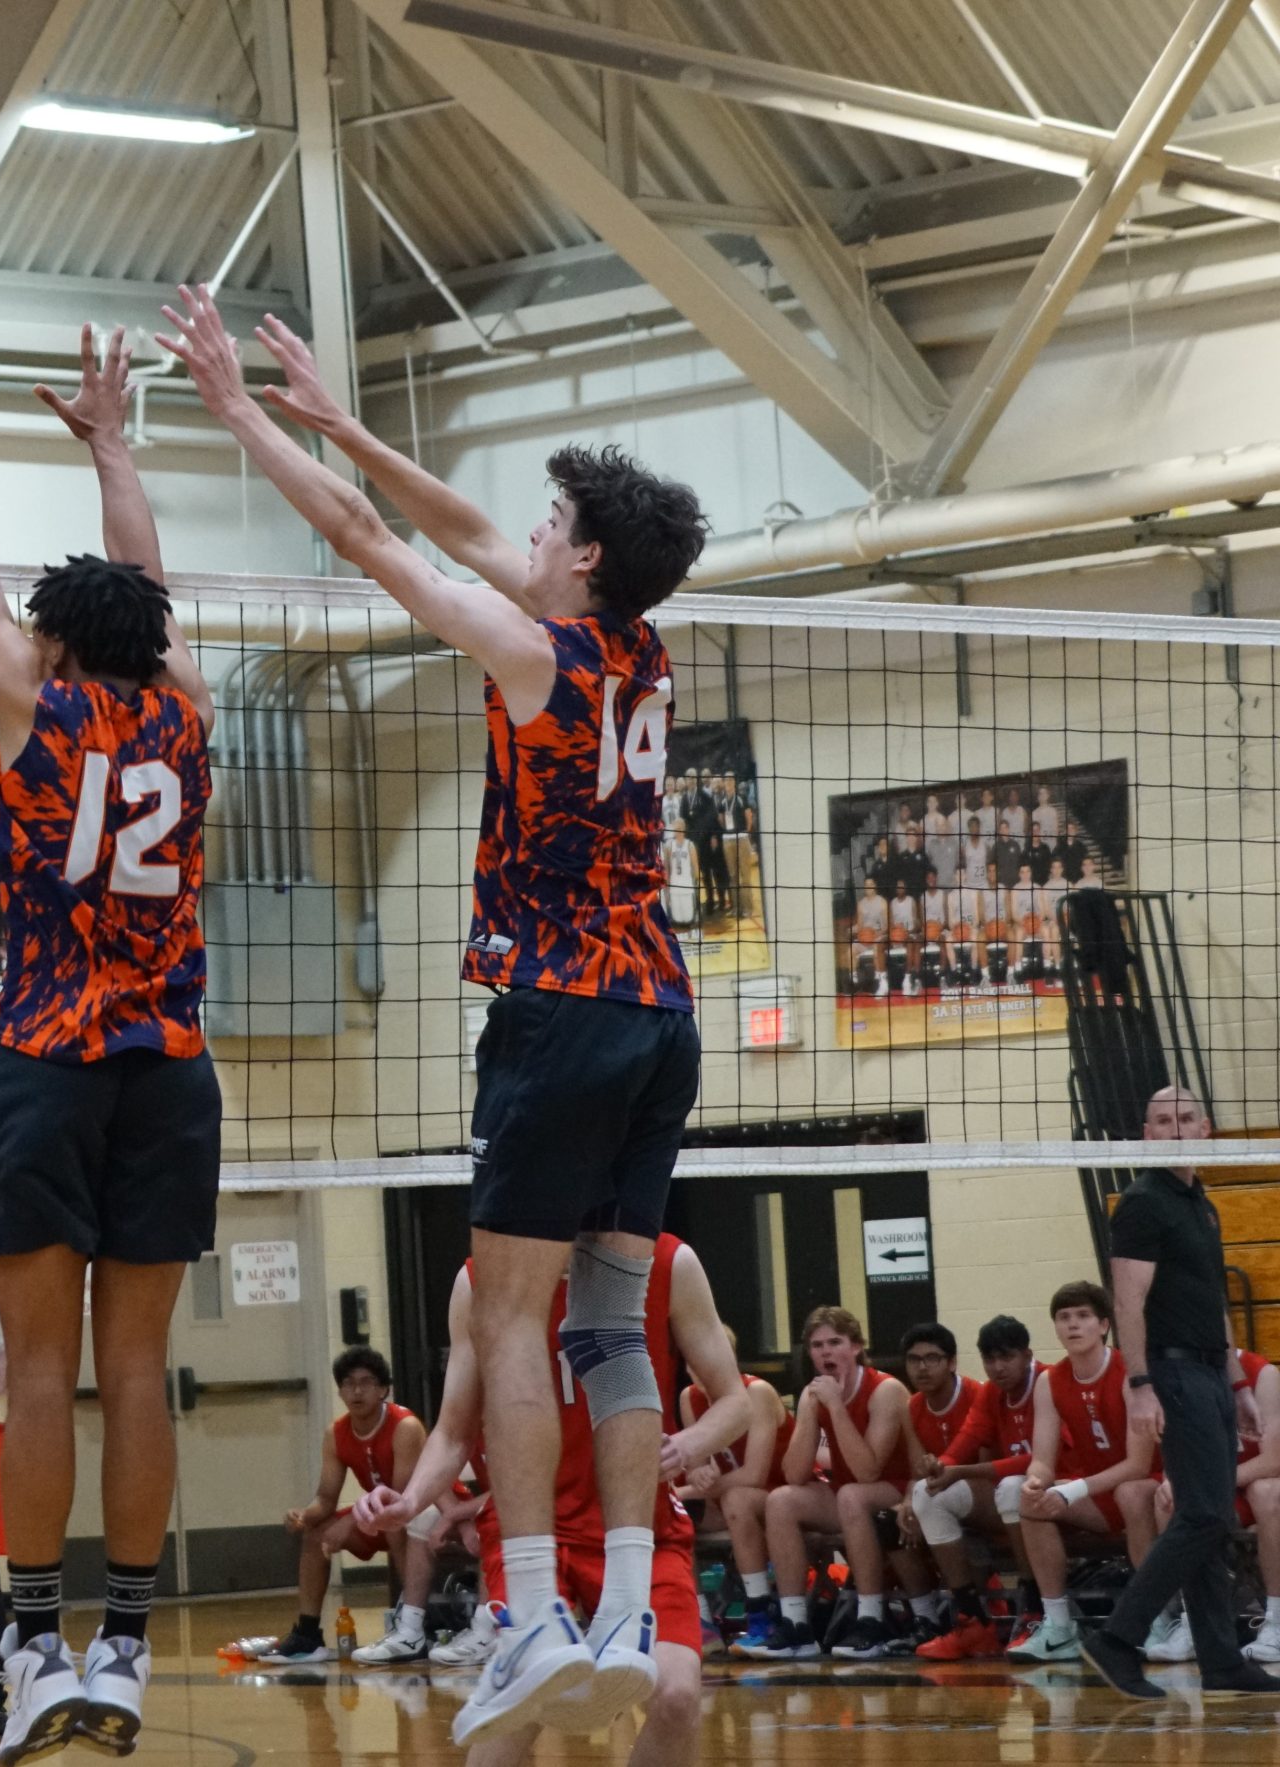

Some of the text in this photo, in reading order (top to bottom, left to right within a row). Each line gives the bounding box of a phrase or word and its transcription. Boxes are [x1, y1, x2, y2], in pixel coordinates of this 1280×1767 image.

[596, 676, 672, 801] 14
[63, 751, 182, 896] 12
[951, 1004, 983, 1016] STATE
[247, 1267, 286, 1280] ALARM
[248, 1289, 286, 1302] SOUND
[1091, 1420, 1111, 1449] 9
